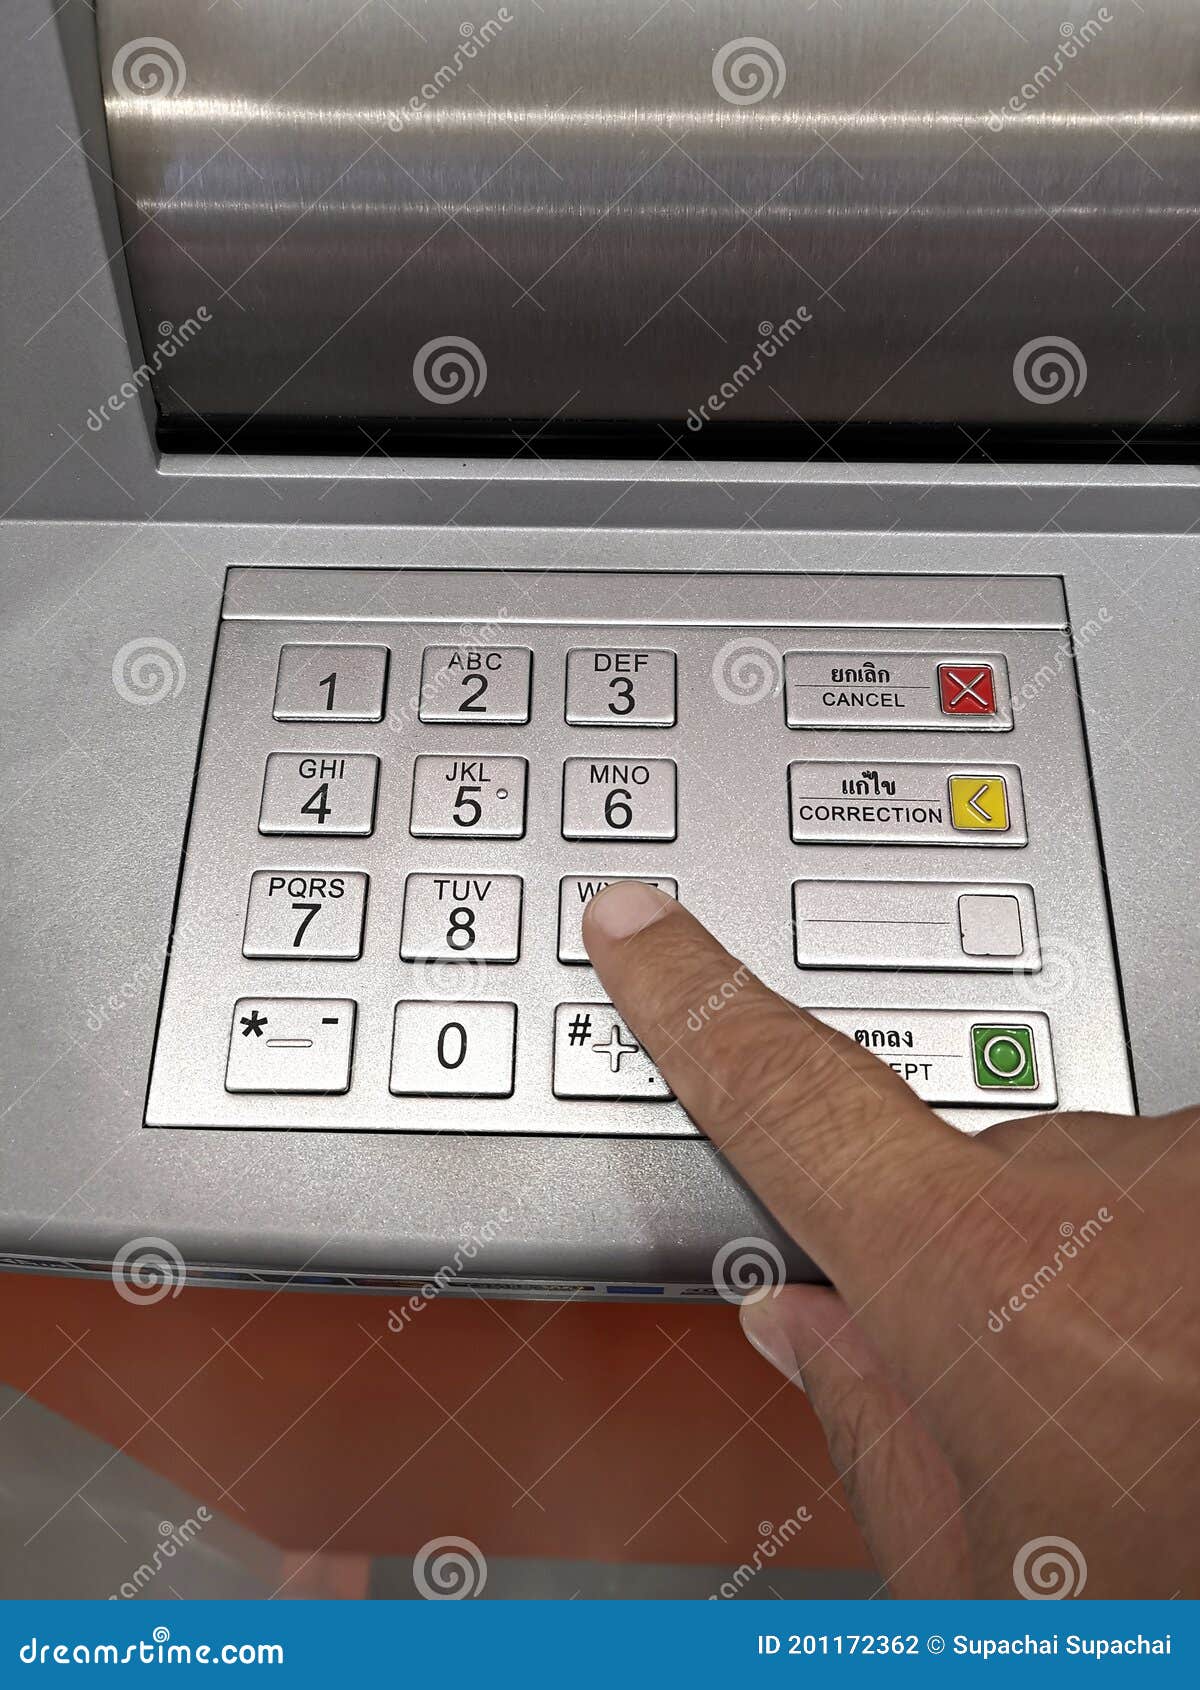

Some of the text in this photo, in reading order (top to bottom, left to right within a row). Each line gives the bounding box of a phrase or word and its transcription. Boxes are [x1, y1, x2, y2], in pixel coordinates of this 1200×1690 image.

[447, 651, 502, 671] ABC
[594, 653, 649, 673] DEF
[831, 661, 891, 684] ยกเลิก
[319, 672, 337, 711] 1
[458, 673, 489, 713] 2
[607, 676, 636, 716] 3
[822, 692, 905, 708] CANCEL
[298, 758, 345, 780] GHI
[445, 761, 491, 782] JKL
[590, 764, 650, 785] MNO
[842, 770, 896, 796] แก้ไข
[300, 782, 332, 824] 4
[452, 785, 482, 827] 5
[604, 788, 633, 830] 6
[799, 805, 943, 824] CORRECTION
[268, 877, 345, 899] PQRS
[433, 879, 492, 902] TUV
[291, 902, 322, 948] 7
[446, 906, 476, 951] 8
[437, 1021, 467, 1070] 0
[854, 1029, 914, 1048] ตกลง
